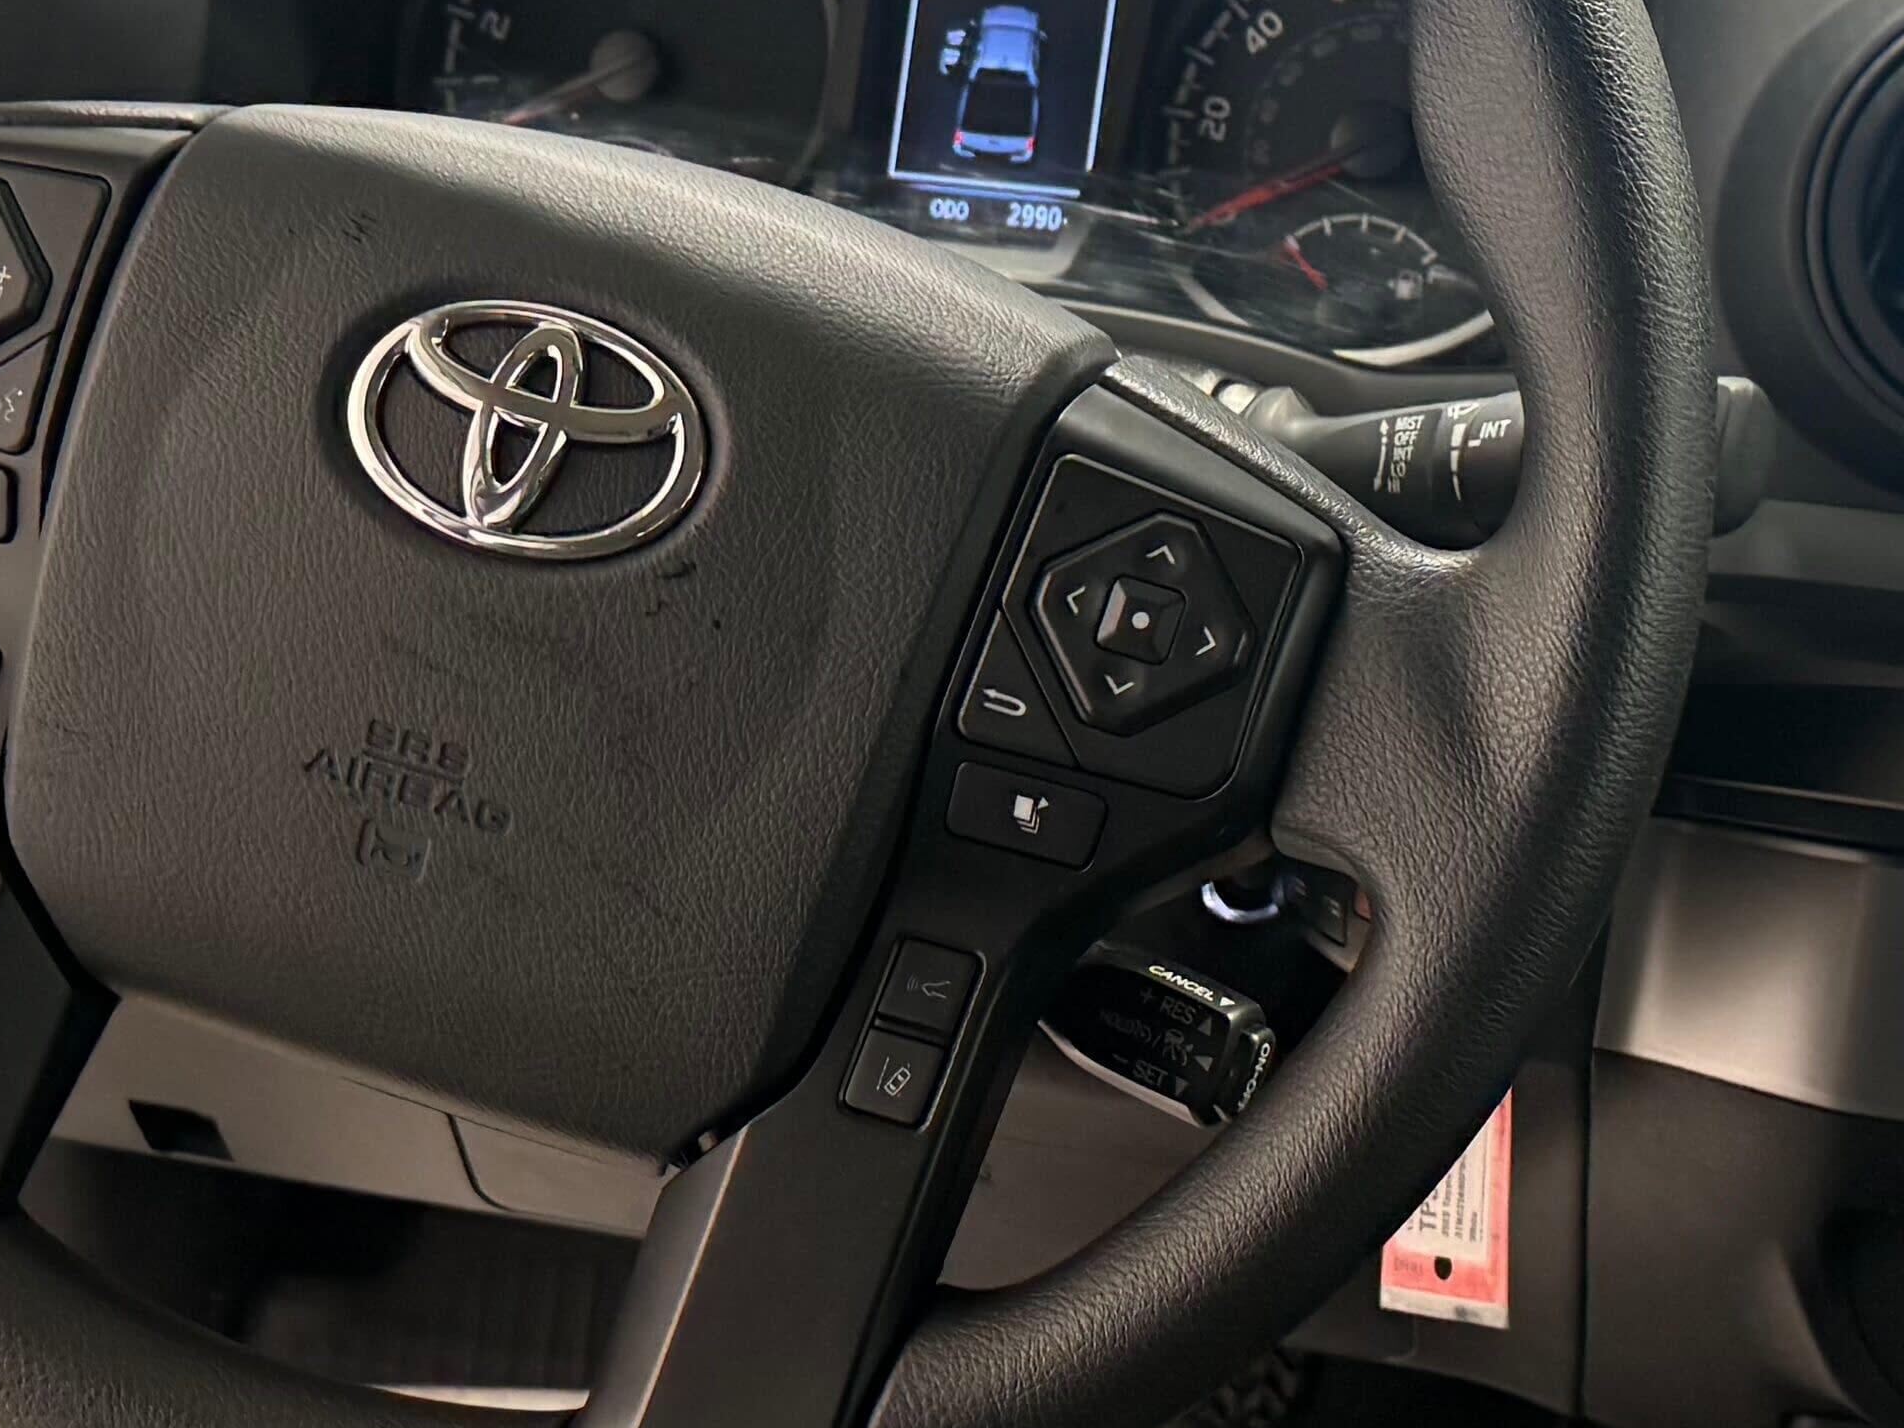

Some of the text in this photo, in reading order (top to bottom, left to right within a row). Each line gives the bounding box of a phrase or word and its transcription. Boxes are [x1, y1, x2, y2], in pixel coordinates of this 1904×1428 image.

[480, 10, 511, 42] 2
[1245, 9, 1284, 55] 40
[1199, 95, 1232, 143] 20
[1479, 419, 1511, 439] INT
[1148, 965, 1215, 1002] CANCEL
